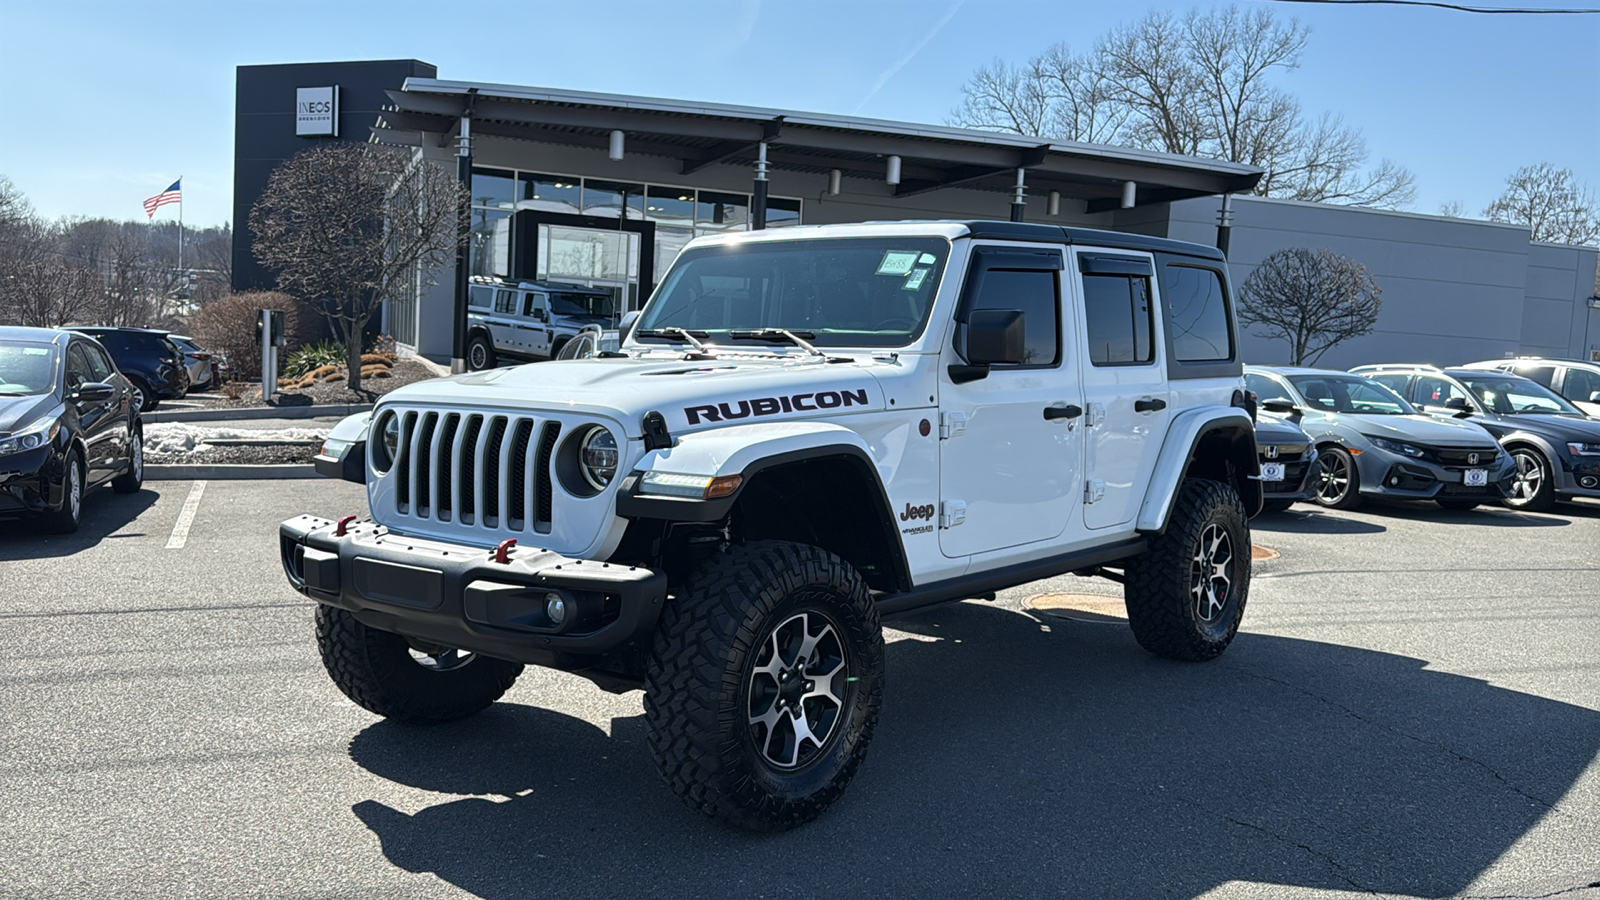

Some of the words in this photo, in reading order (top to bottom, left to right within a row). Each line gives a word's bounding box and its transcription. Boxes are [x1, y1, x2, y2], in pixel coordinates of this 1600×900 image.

[299, 101, 330, 113] INEOS
[684, 388, 869, 425] RUBICON
[900, 503, 935, 521] Jeep
